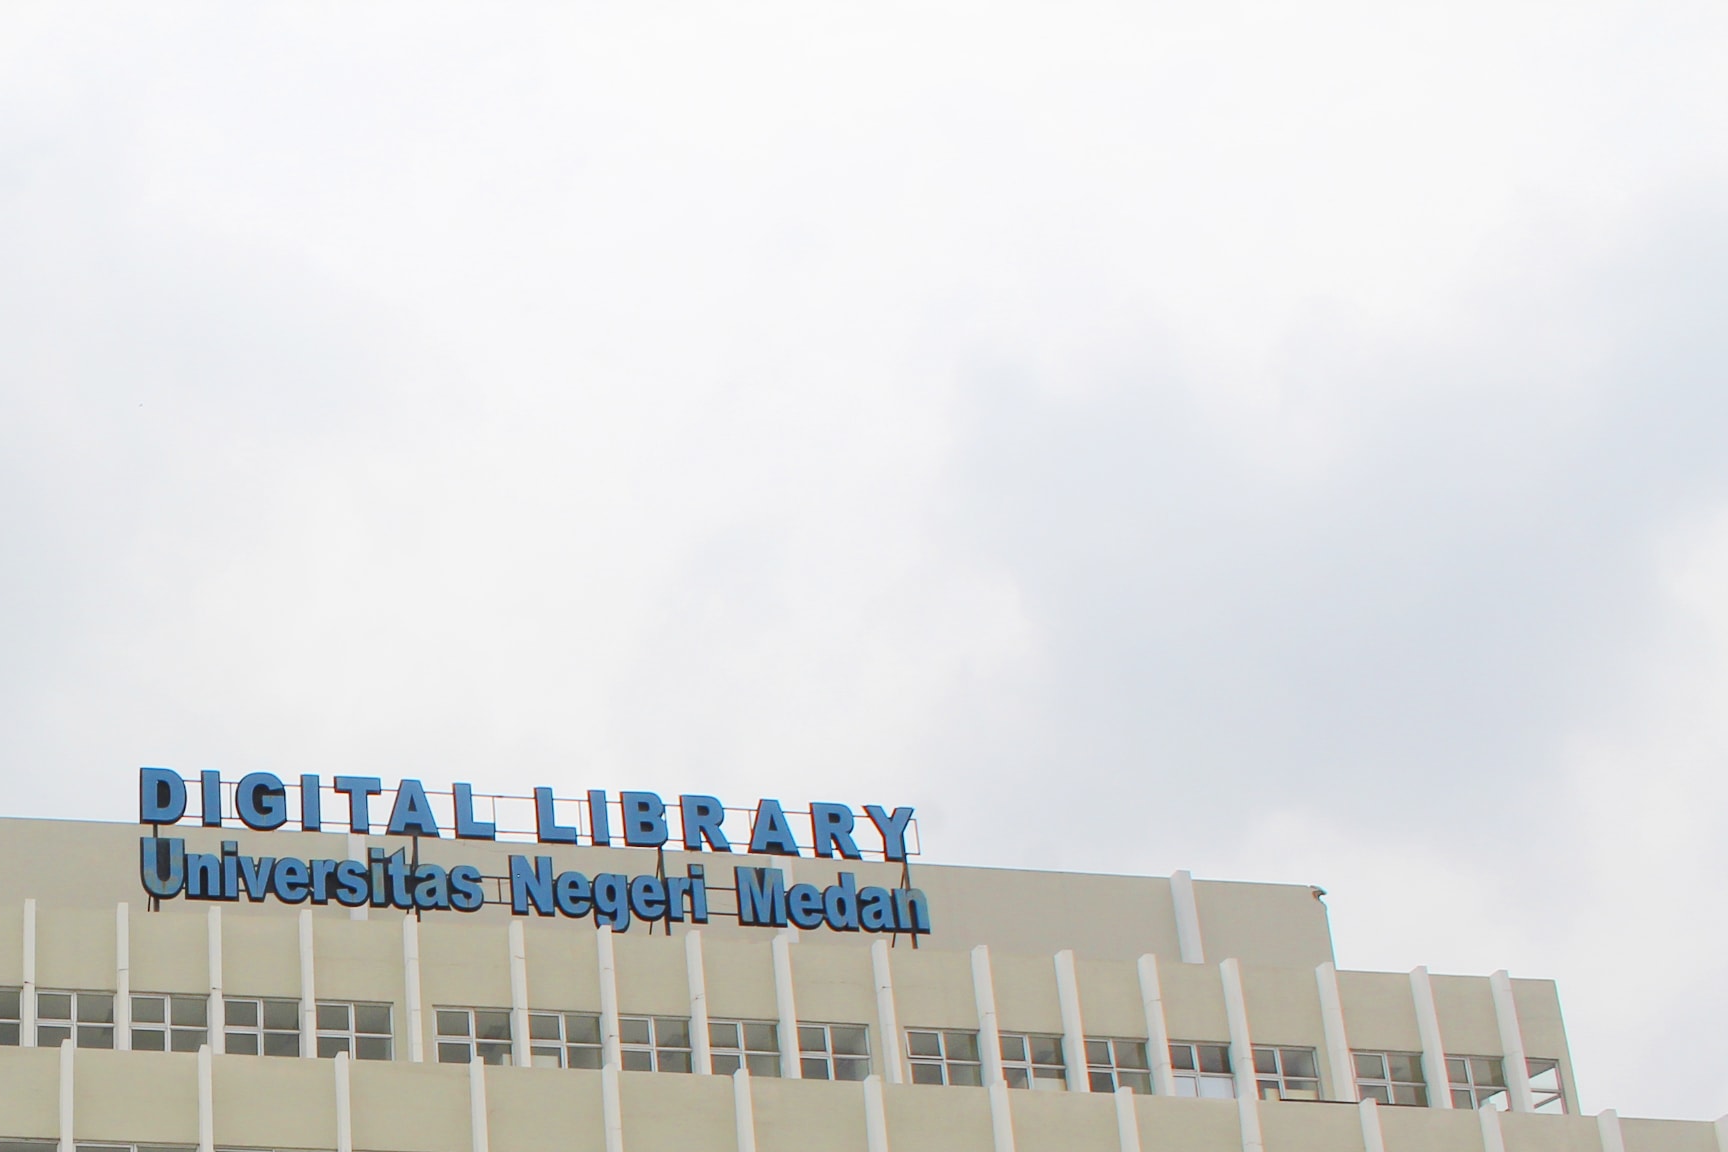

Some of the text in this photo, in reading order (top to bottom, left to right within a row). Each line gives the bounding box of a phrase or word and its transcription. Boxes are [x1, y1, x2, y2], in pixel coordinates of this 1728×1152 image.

[140, 767, 914, 863] DIGITAL LIBRARY
[140, 837, 931, 935] Universitas Negeri Medan
